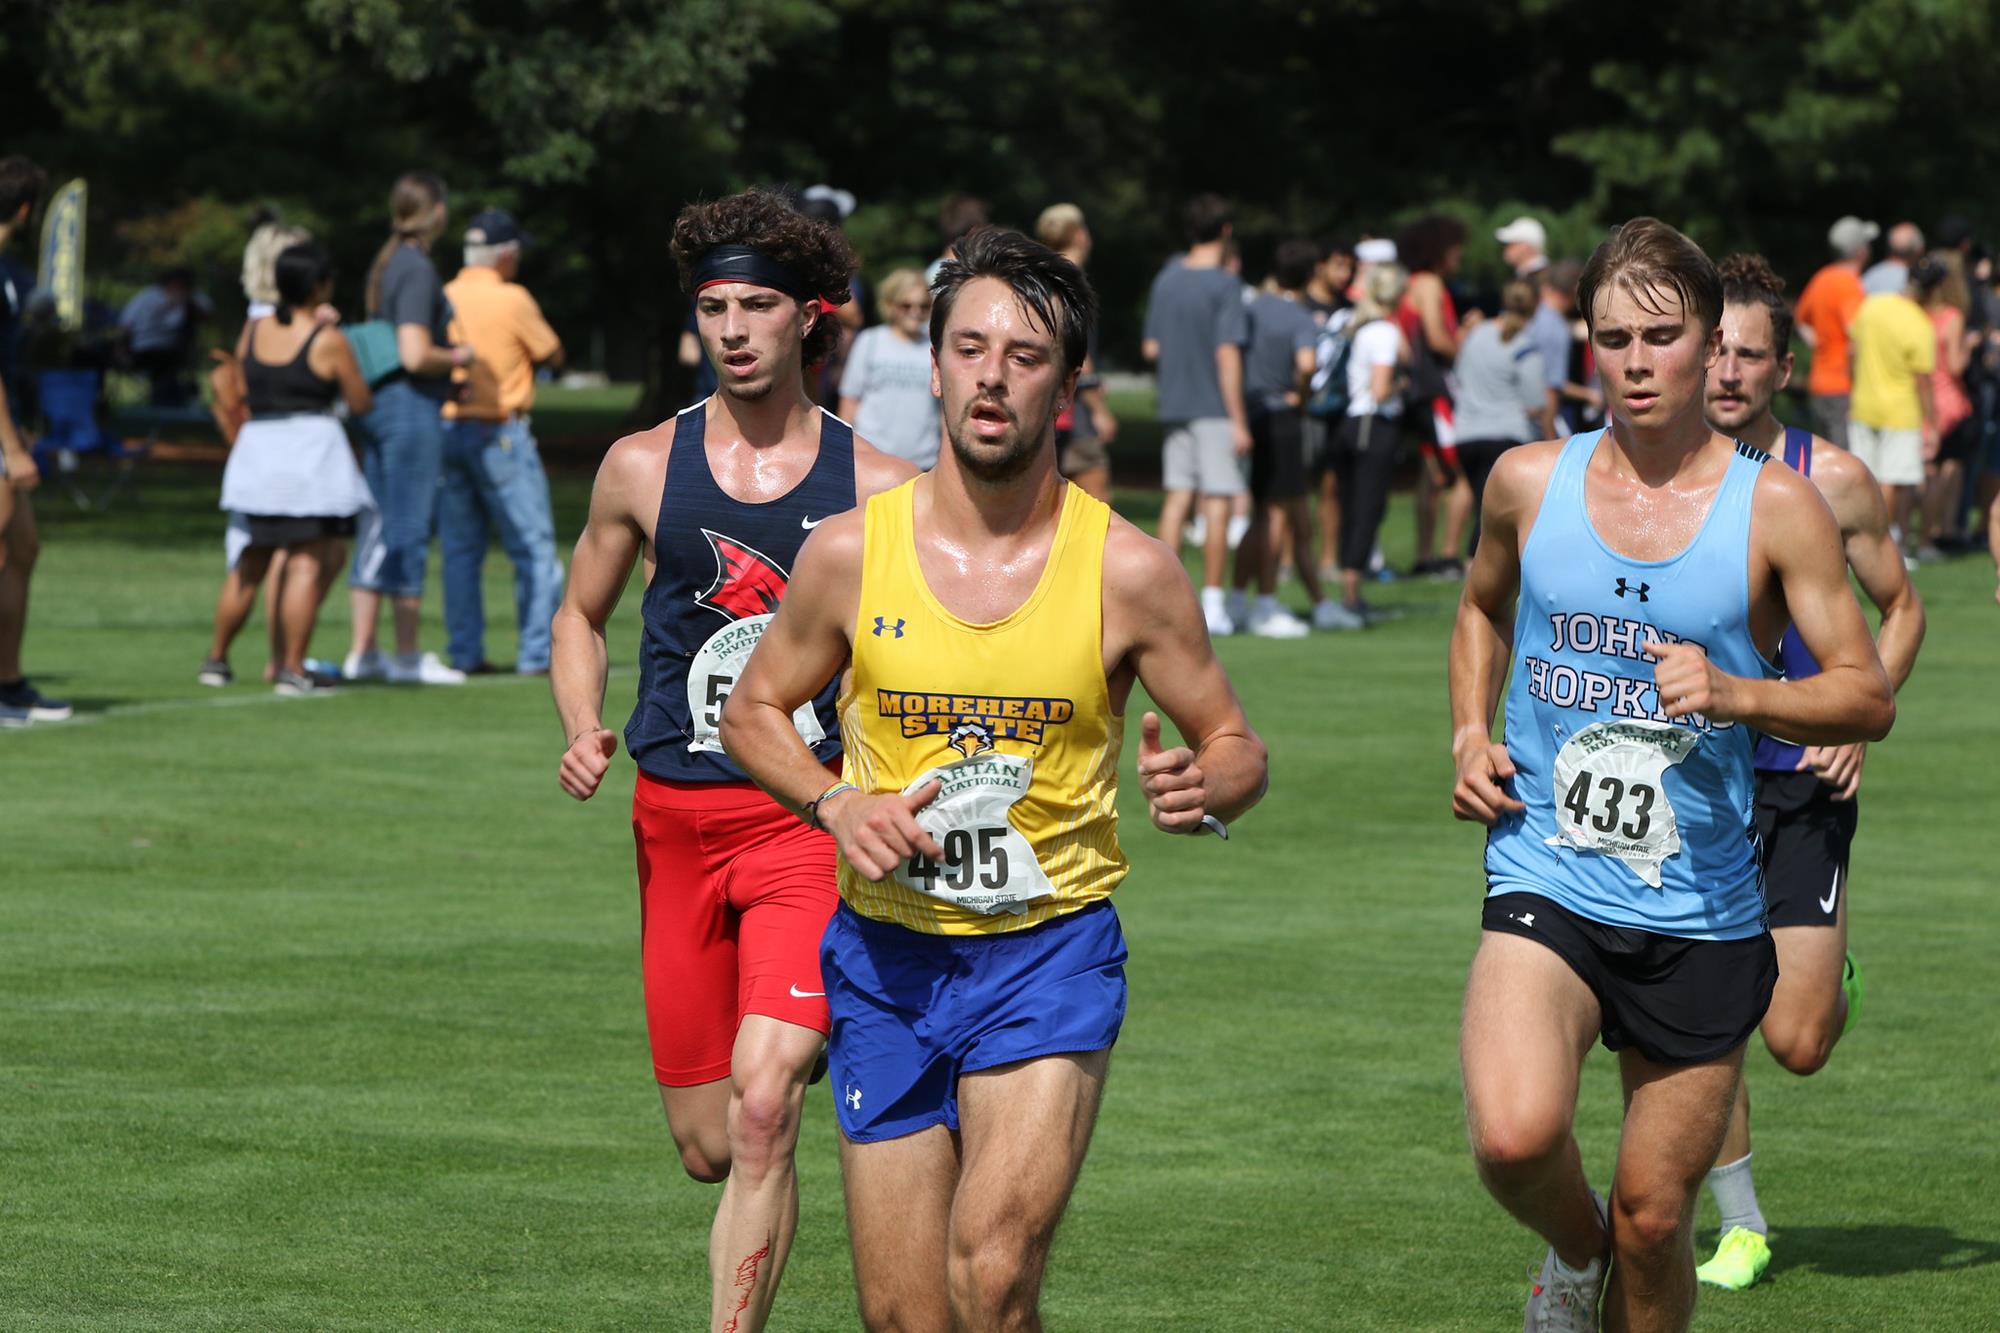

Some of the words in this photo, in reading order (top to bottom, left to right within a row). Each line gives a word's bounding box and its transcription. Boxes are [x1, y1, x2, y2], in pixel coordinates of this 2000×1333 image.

[711, 622, 770, 653] SPAR
[1550, 612, 1708, 665] JOHN
[877, 689, 1073, 724] MOREHEAD
[1526, 656, 1735, 731] HOPK
[1580, 723, 1682, 746] SPARTAN
[919, 762, 1020, 789] ARTAN
[920, 777, 1021, 813] ITATIONAL
[1564, 770, 1655, 840] 433
[908, 827, 1009, 891] 495
[956, 896, 993, 904] MICHIGAN
[995, 893, 1017, 904] STATE
